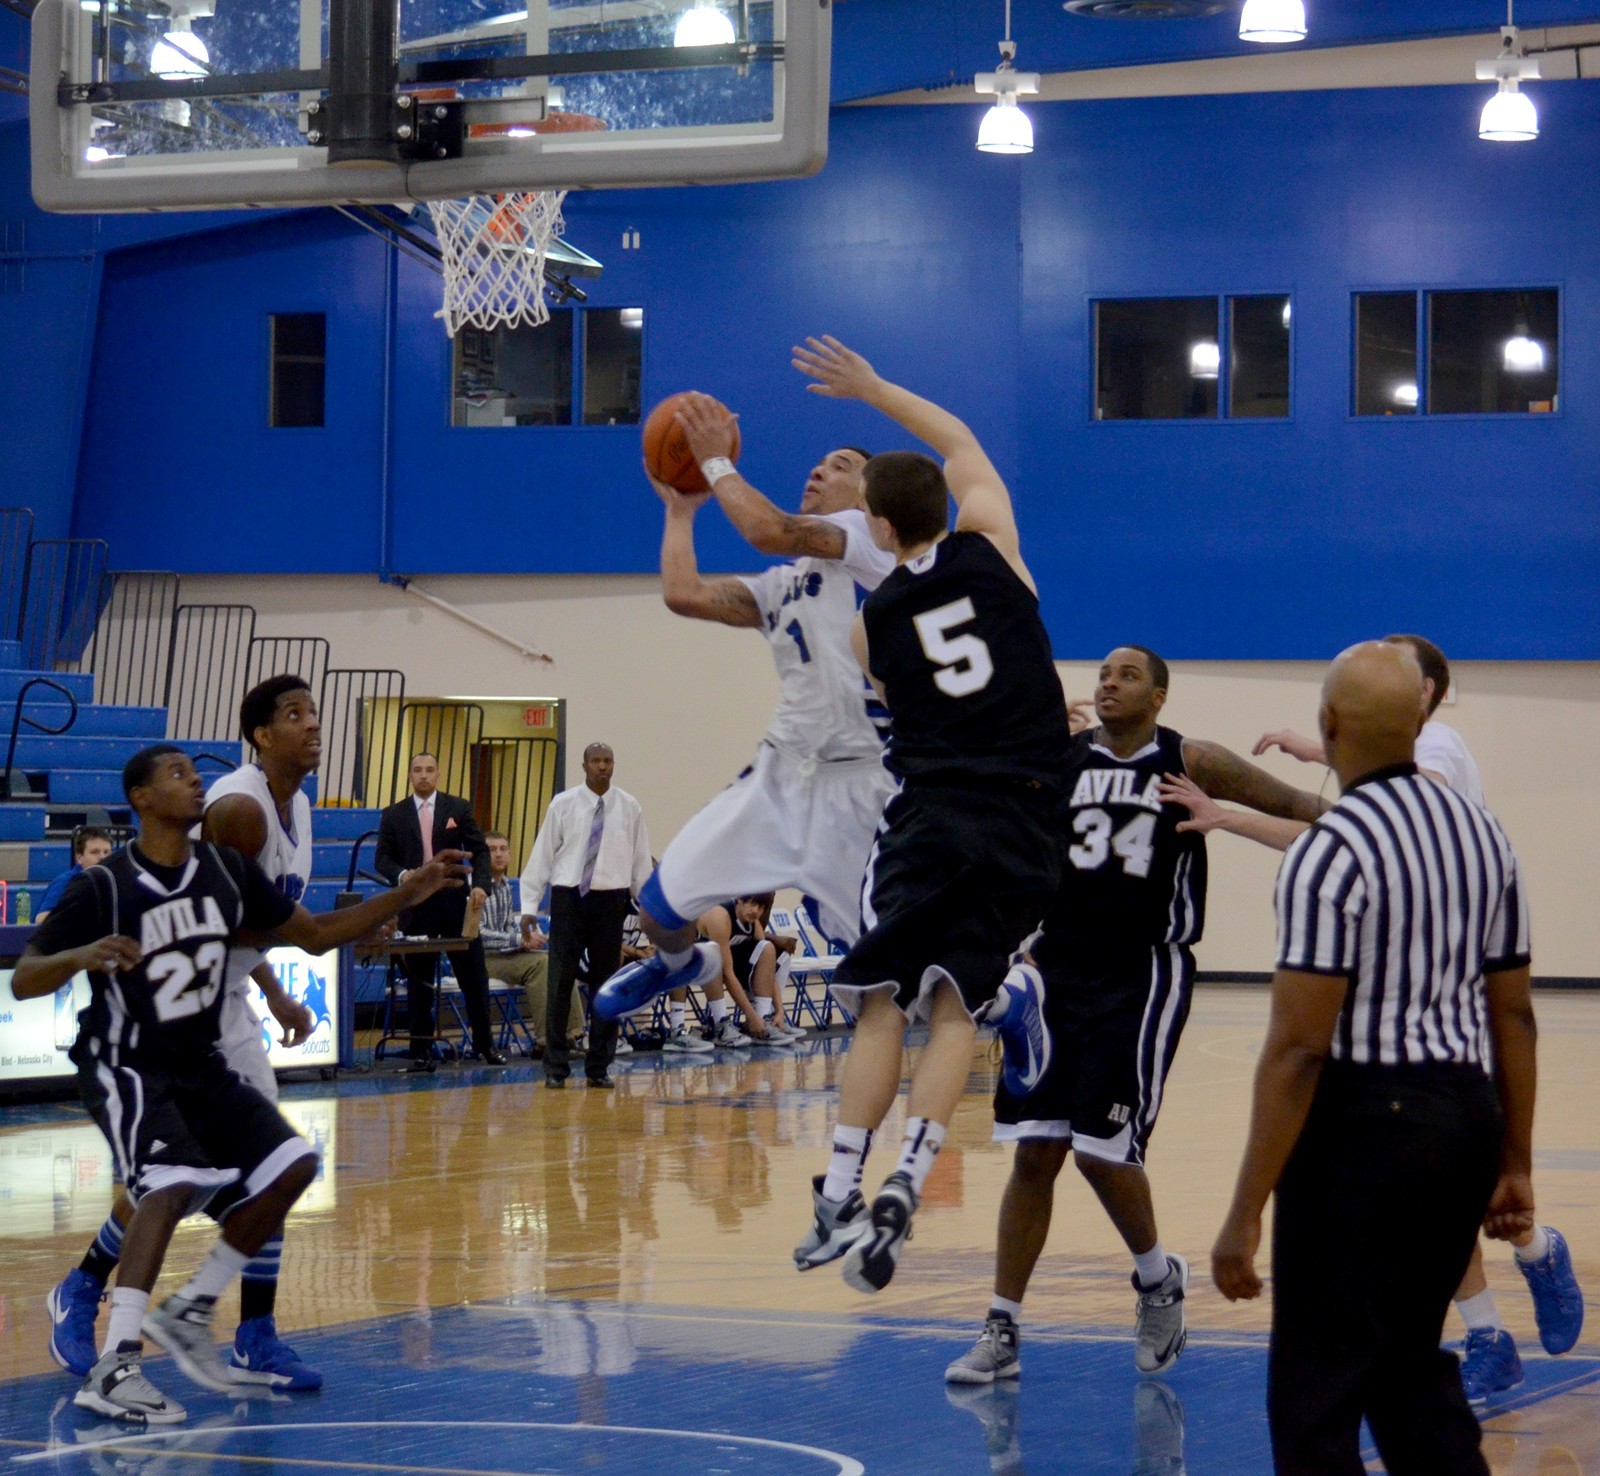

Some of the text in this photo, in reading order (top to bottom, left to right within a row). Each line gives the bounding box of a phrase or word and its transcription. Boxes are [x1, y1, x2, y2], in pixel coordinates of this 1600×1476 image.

[786, 618, 811, 664] 1
[913, 596, 994, 698] 5
[527, 708, 546, 726] EXIT
[1069, 768, 1162, 813] AVILA
[1069, 808, 1157, 878] 34
[141, 896, 229, 956] AVILA
[772, 913, 791, 927] PERU
[146, 941, 225, 1022] 23
[17, 1055, 41, 1065] Nebraska
[43, 1054, 53, 1065] City
[302, 1040, 330, 1055] Bobcats
[1107, 1103, 1130, 1124] AU
